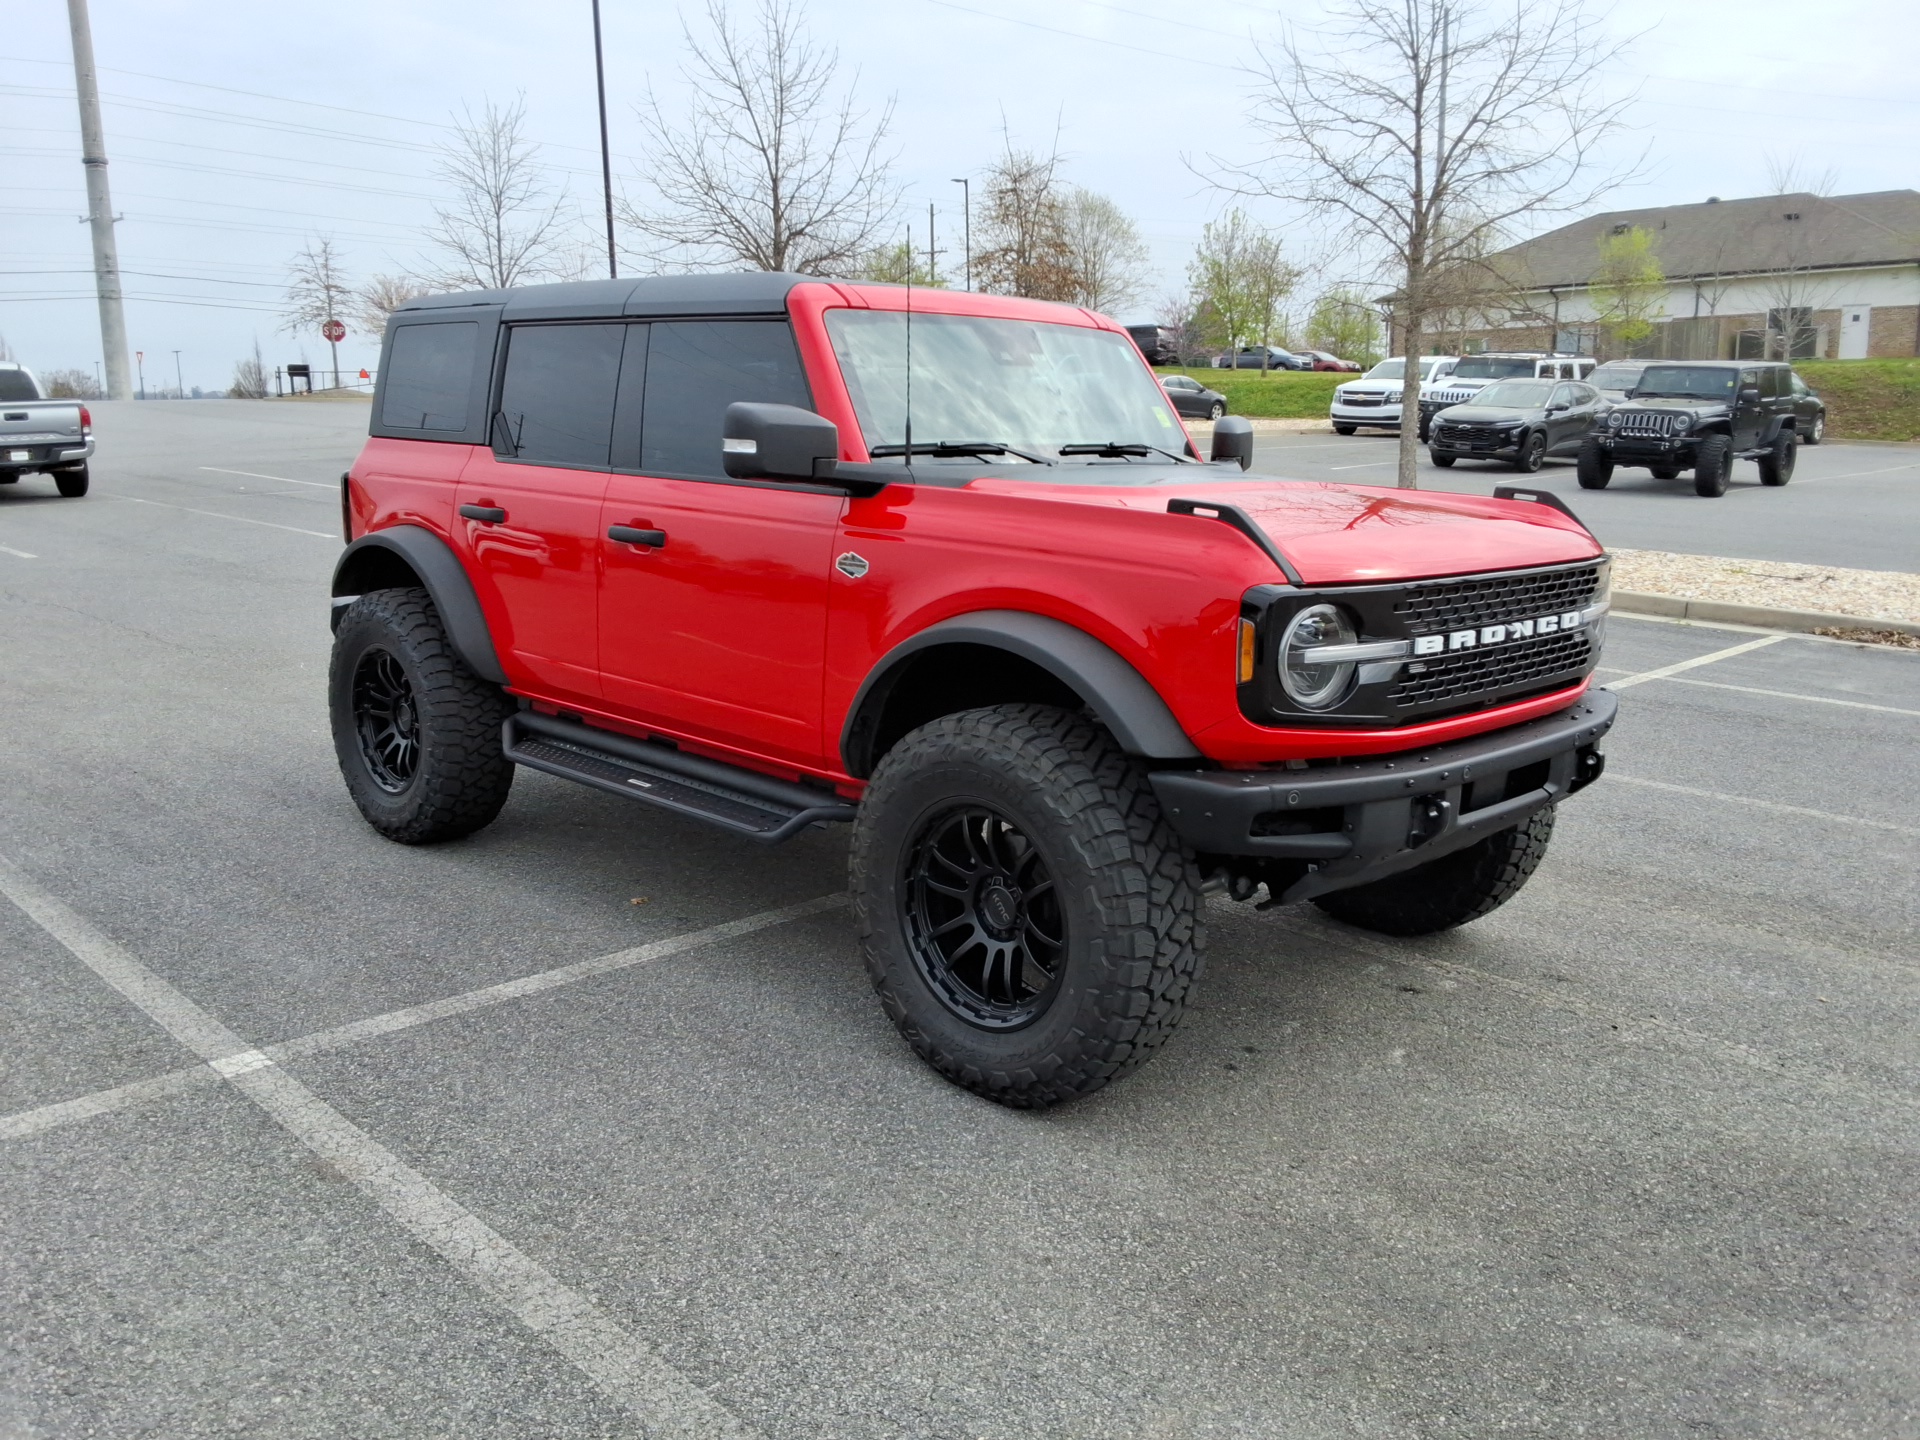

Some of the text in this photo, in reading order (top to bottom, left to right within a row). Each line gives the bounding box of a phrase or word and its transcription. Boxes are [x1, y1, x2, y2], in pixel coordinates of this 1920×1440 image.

[323, 326, 345, 336] SOP
[1414, 611, 1580, 655] BRONCO
[992, 893, 1010, 922] KMC
